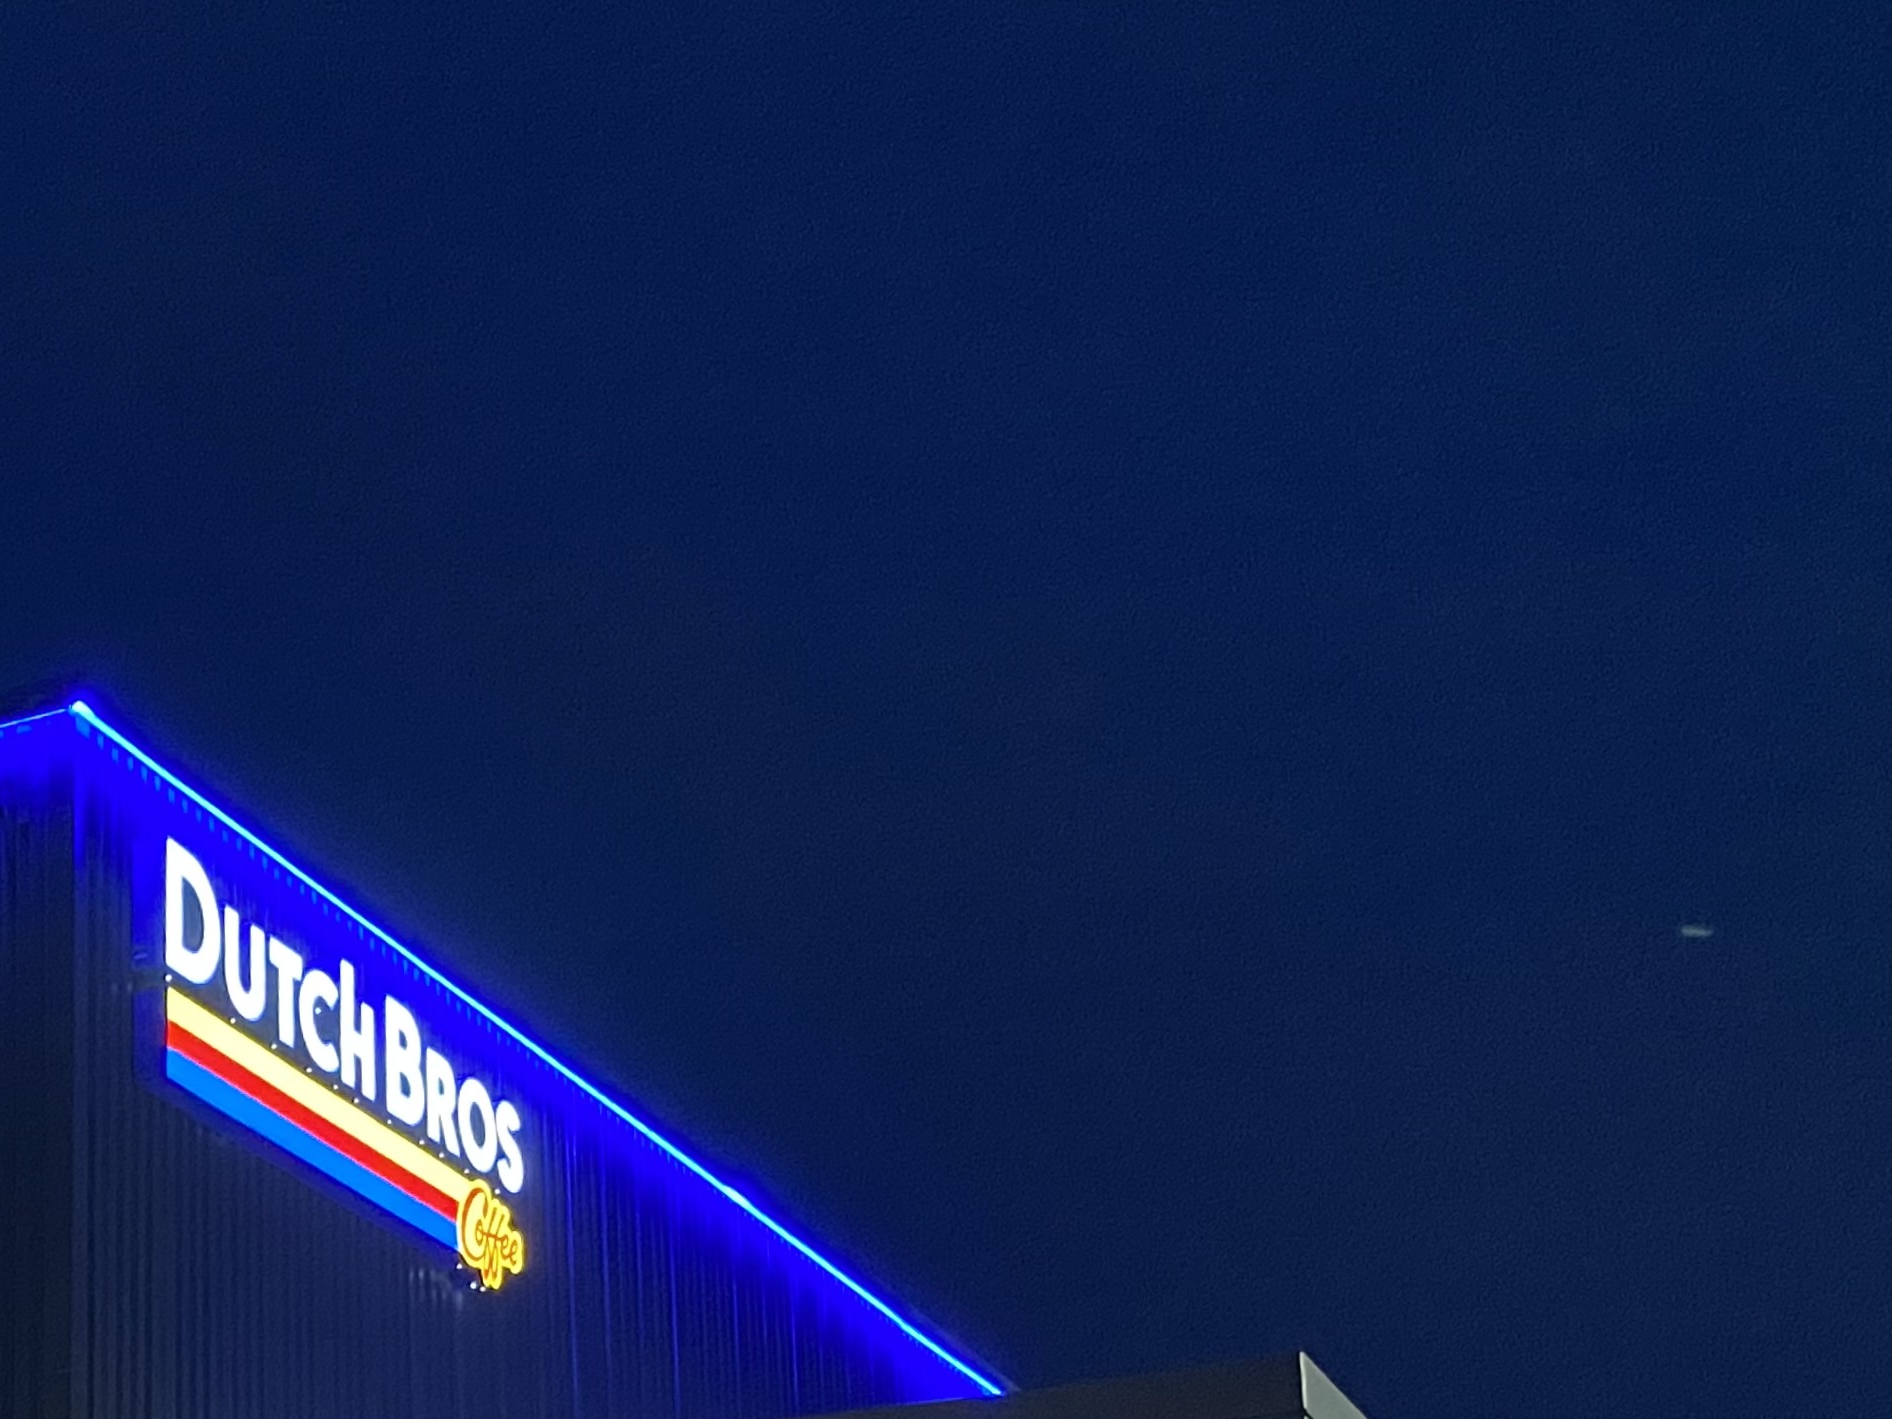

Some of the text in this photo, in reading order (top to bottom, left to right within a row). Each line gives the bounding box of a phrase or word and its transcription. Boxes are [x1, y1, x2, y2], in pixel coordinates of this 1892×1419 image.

[166, 836, 524, 1193] DUTCH BROS
[459, 1183, 521, 1285] Coffee
